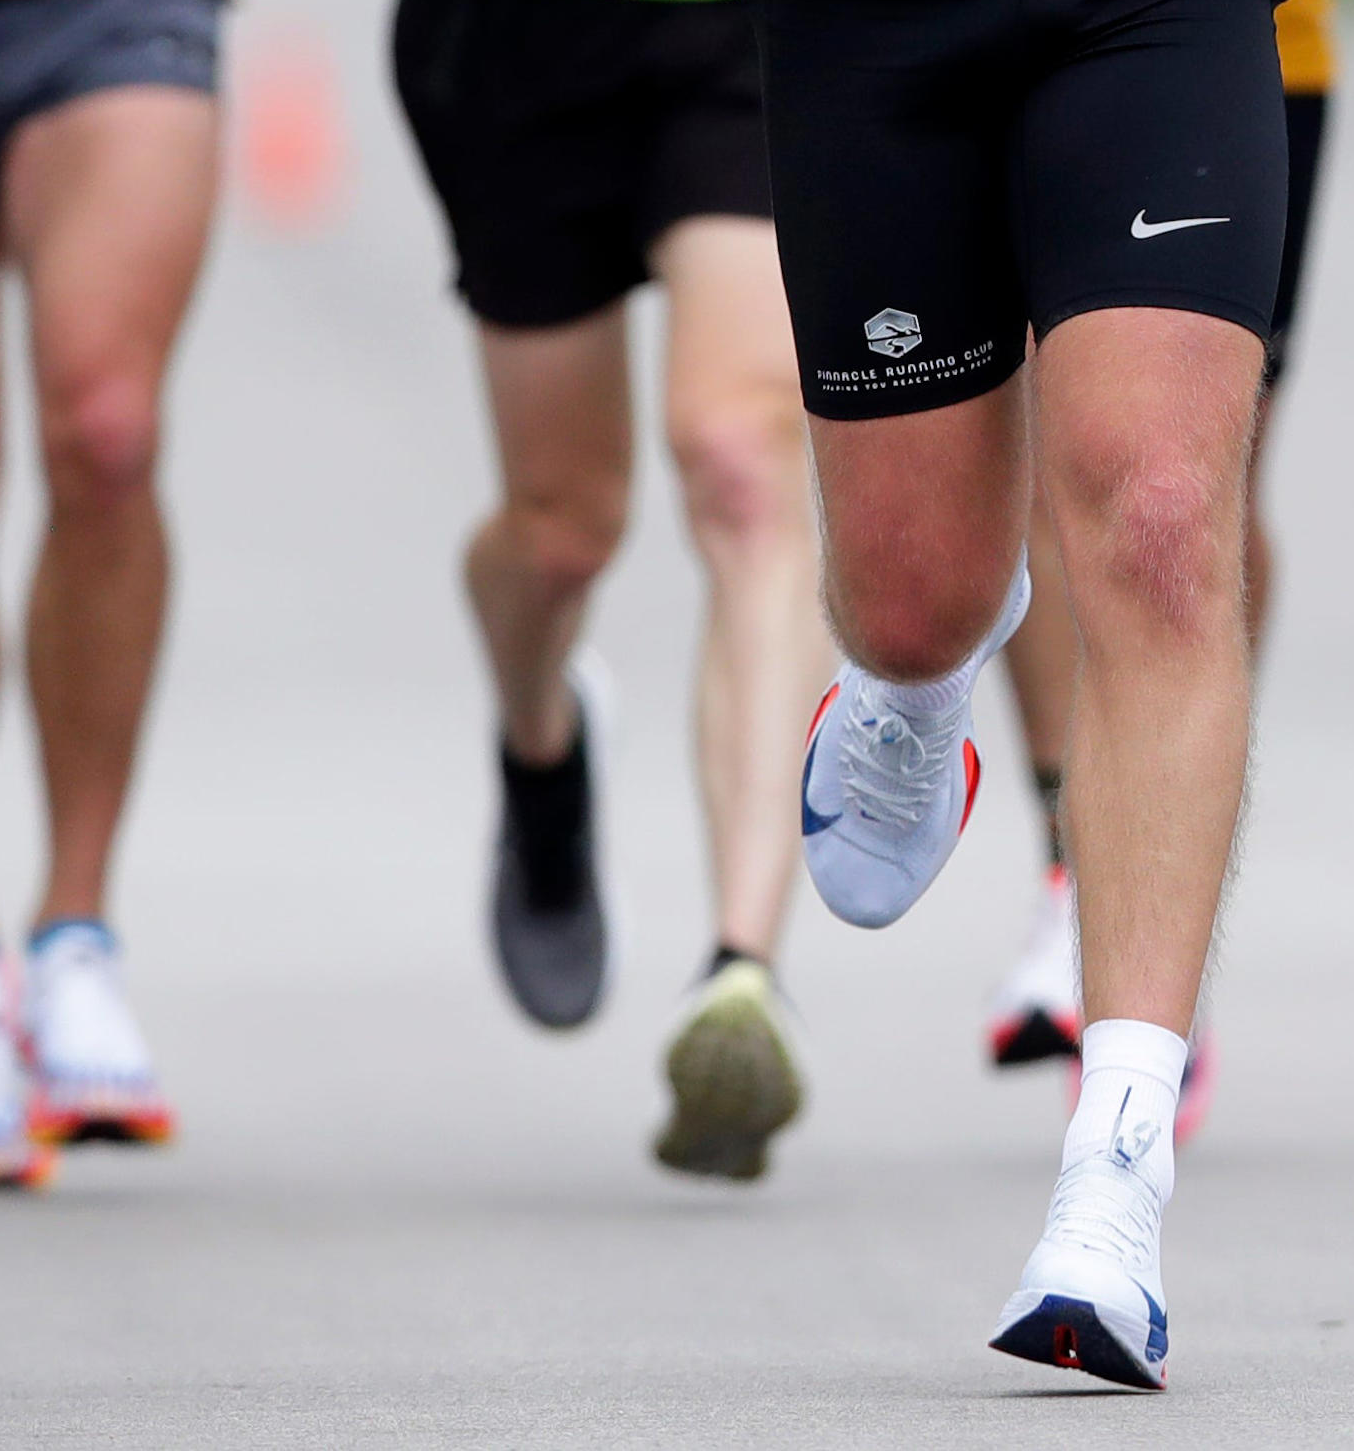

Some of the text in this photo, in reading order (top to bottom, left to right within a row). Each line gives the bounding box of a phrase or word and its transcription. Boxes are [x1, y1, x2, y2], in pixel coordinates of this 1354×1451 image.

[817, 340, 994, 382] PINNACLE RUNNING CLUB
[864, 382, 886, 390] YOU
